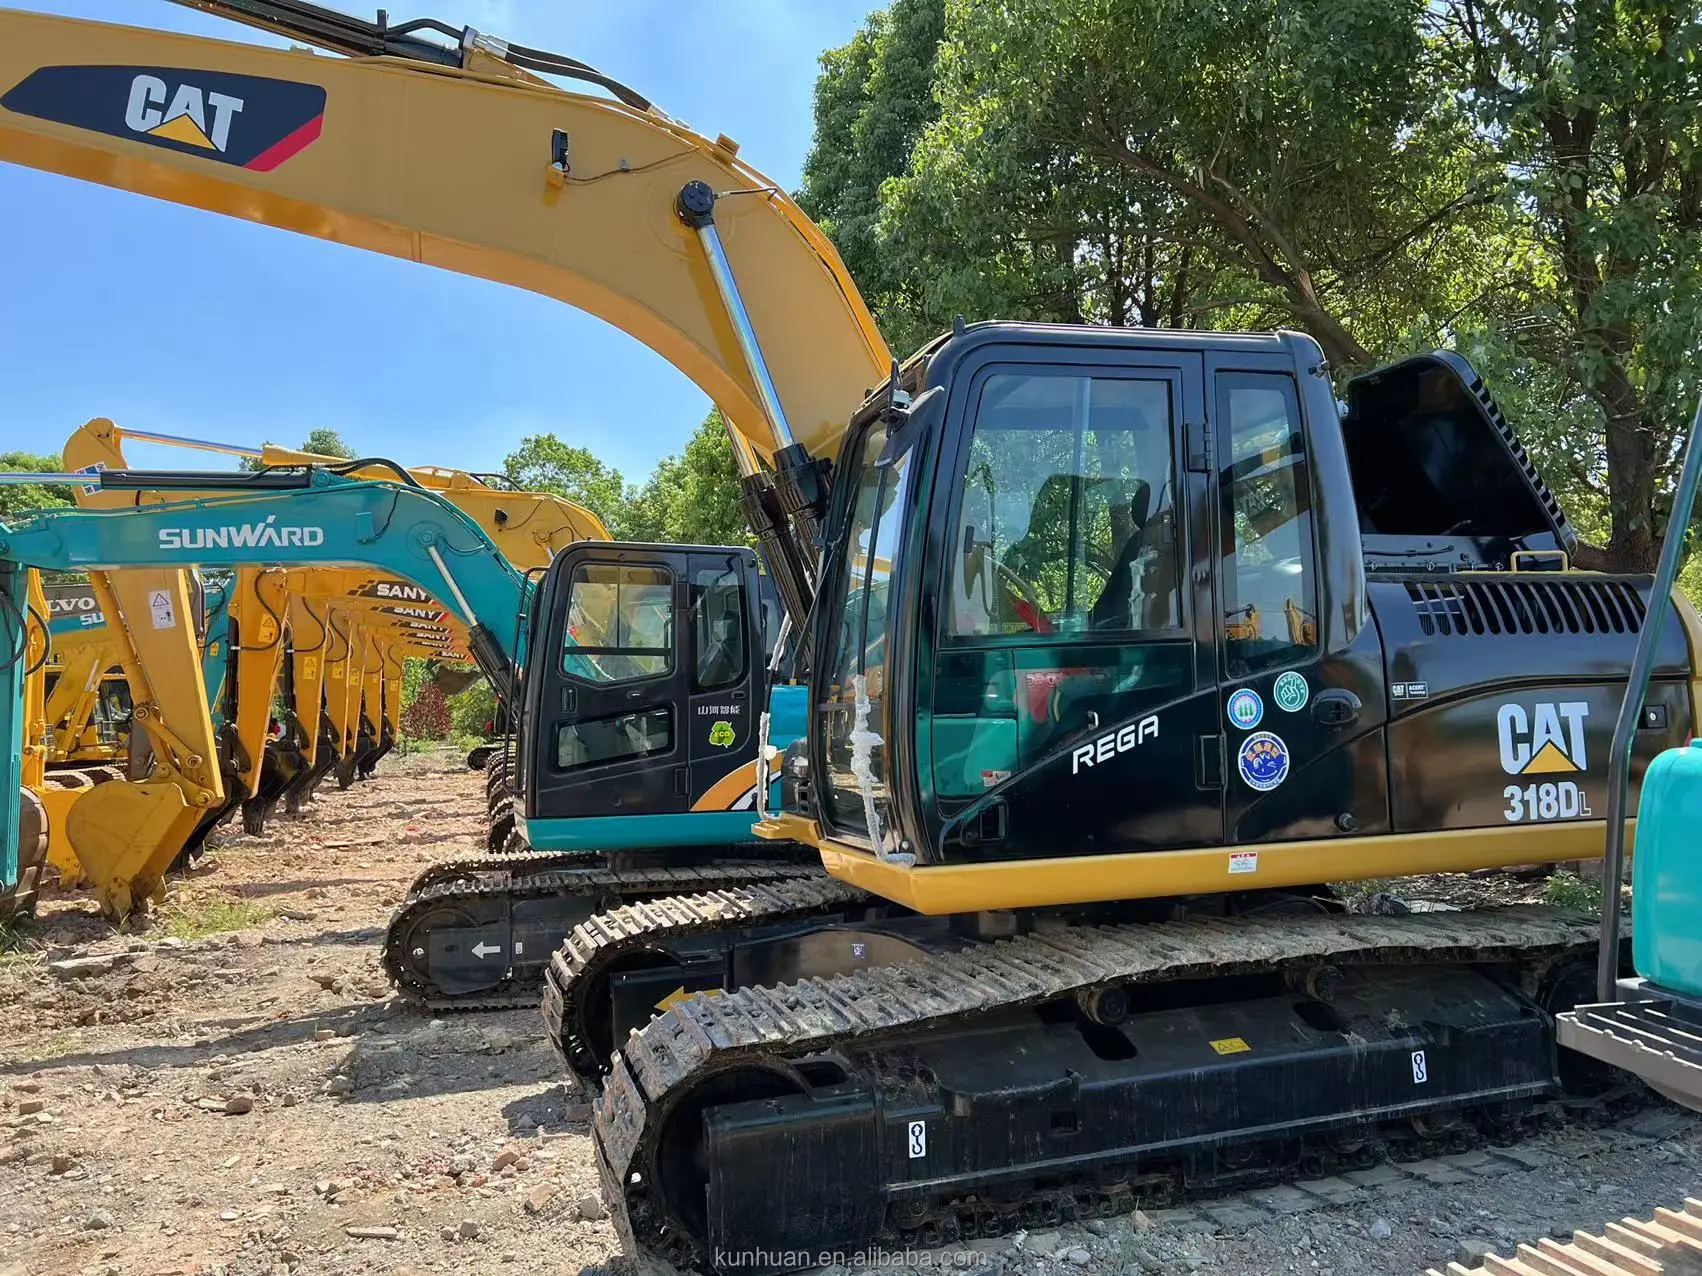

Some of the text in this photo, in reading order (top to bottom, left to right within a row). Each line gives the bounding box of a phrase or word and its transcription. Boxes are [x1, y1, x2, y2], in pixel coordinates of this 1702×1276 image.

[125, 74, 244, 152] CAT
[159, 515, 324, 549] SUNWARD
[47, 597, 95, 612] LVO
[377, 583, 427, 600] SANY
[698, 705, 741, 715] 山河智能
[1072, 715, 1159, 774] REGA
[1497, 702, 1589, 775] CAT
